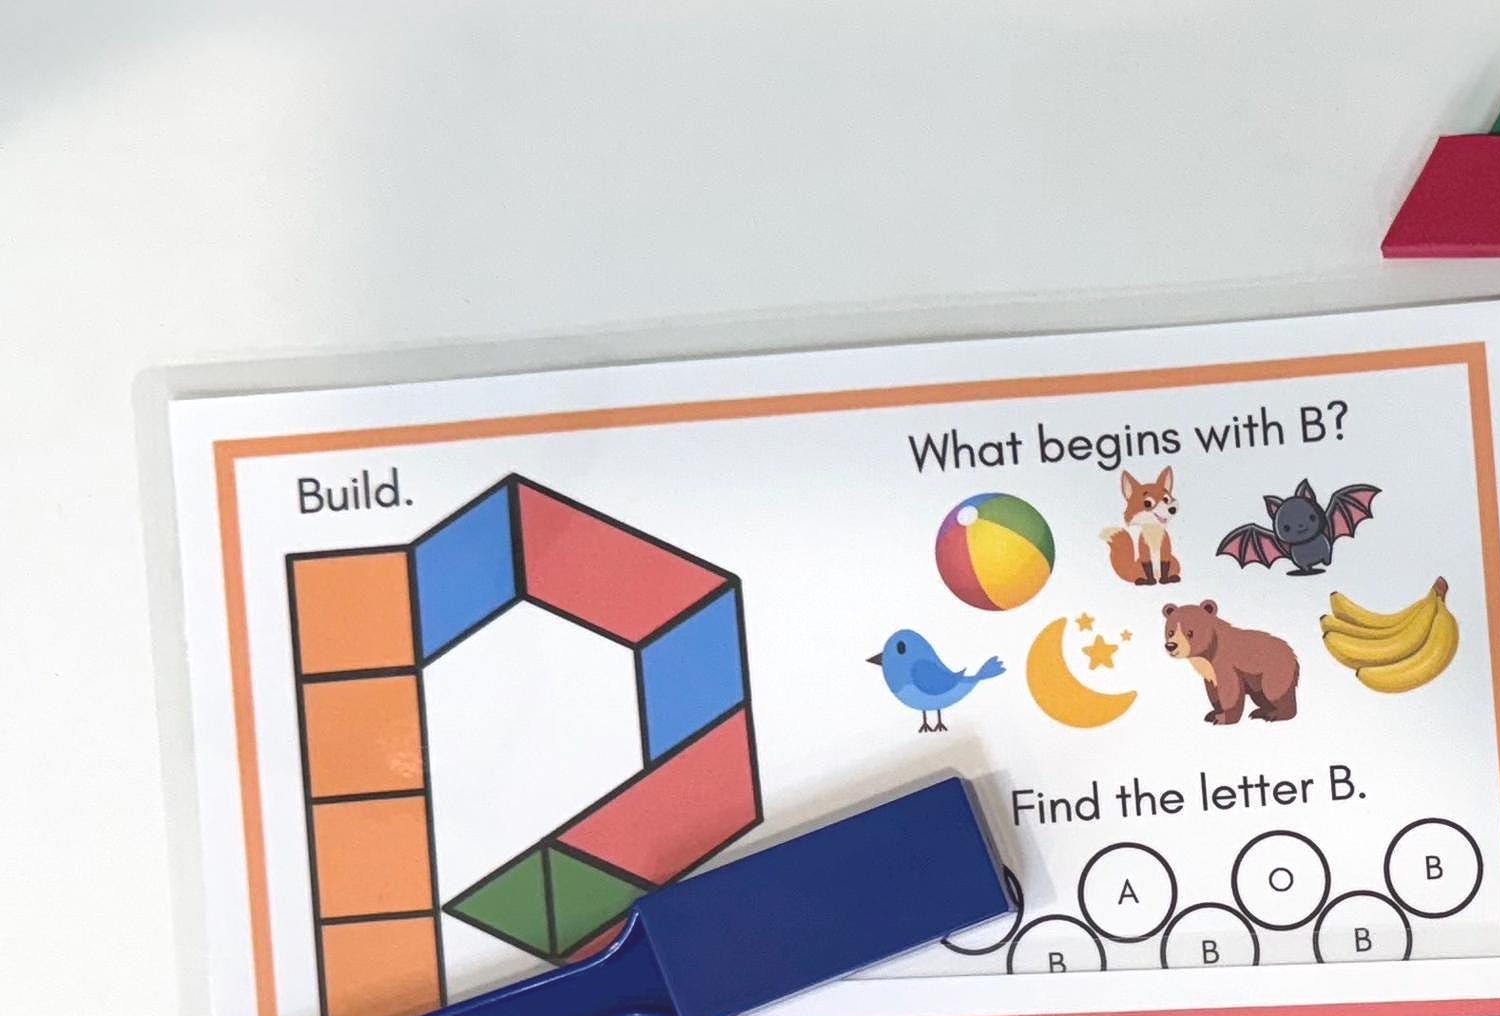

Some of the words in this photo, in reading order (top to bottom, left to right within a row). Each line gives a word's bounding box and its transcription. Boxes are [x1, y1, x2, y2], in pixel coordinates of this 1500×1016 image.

[908, 429, 1022, 473] What
[1038, 423, 1181, 472] begins
[1194, 407, 1284, 453] with
[1300, 400, 1348, 443] B?
[298, 467, 413, 514] Build.
[1011, 781, 1100, 826] Find
[1116, 778, 1184, 817] the
[1200, 772, 1314, 811] letter
[1329, 765, 1366, 800] B.
[1118, 879, 1139, 905] A
[1269, 867, 1294, 892] O
[1426, 855, 1443, 880] B
[1049, 953, 1066, 973] B
[1202, 940, 1219, 964] B
[1354, 928, 1372, 952] B
